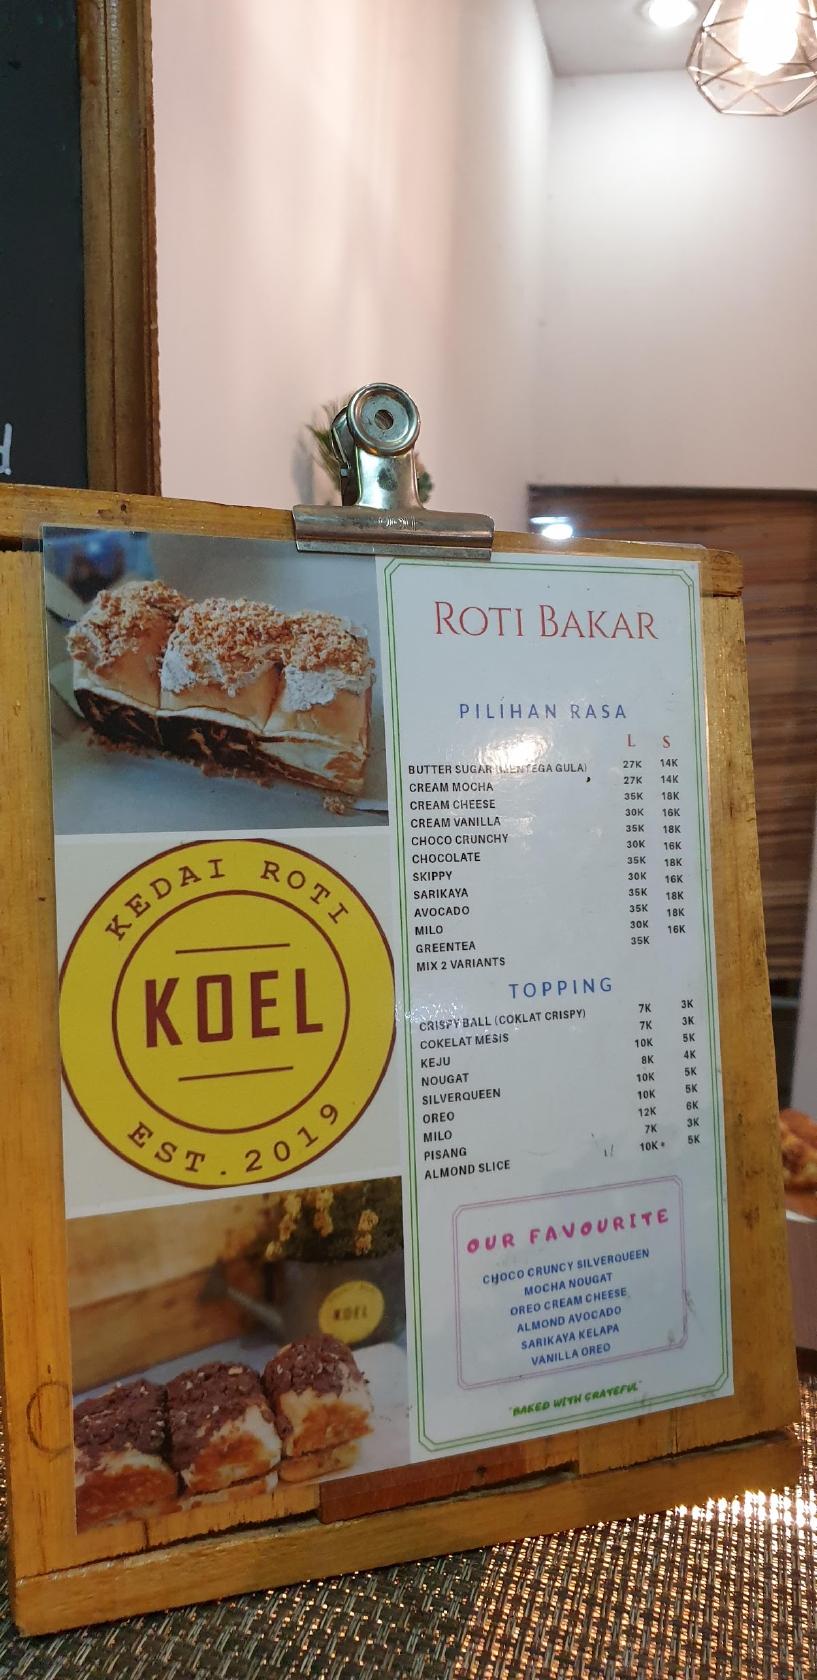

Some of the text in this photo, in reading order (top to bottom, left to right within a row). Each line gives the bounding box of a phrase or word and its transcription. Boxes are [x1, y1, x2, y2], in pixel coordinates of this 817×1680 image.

[460, 703, 626, 719] PILIHAN RASA
[627, 734, 670, 748] L S
[409, 765, 451, 774] BUTTER
[456, 765, 492, 774] SUGAR
[556, 763, 587, 772] GULA)
[623, 760, 642, 768] 27K
[660, 758, 678, 767] 14K
[409, 775, 679, 793] CREAM MOCHA 27K 14K
[410, 792, 679, 810] CREAM CHEESE 35K 18K
[410, 808, 680, 828] CREAM VANILLA 30K 16K
[411, 824, 681, 846] CHOCO CRUNCHY 35K 18K
[412, 840, 682, 864] CHOCOLATE 30K 16K
[413, 856, 682, 882] SKIPPY 35K 18K
[104, 858, 349, 941] KEDAI ROTI
[413, 872, 683, 900] SARIKAYA 30K 16K
[414, 888, 684, 918] AVOCADO 35K 18K
[415, 904, 685, 936] MILO 35K 18K
[416, 920, 686, 953] GREENTEA 30K 16K
[417, 936, 650, 972] MIX 2 VARIANTS 35K
[509, 977, 612, 999] TOPPING
[145, 968, 324, 1048] KOEL
[419, 999, 694, 1031] CRISPY BALL (COKLAT CRISPY) 7K 3K
[421, 1016, 694, 1049] COKELAT MESIS 7K 3K
[420, 1033, 695, 1068] KEJU 10K 5K
[421, 1050, 696, 1087] NOUGAT 8K 4K
[422, 1067, 697, 1105] SILVERQUEEN 10K 5K
[423, 1084, 698, 1124] OREO 10K 5K
[423, 1101, 699, 1142] MILO 12K 6K
[424, 1118, 699, 1161] PISANG 7K 3K
[424, 1135, 700, 1180] ALMOND SLICE 10K 5K
[467, 1208, 669, 1254] OUR FAVOURITE
[483, 1248, 650, 1284] CHOCO CRUNCY SILVERQUEEN
[524, 1273, 613, 1296] MOCHA NOUGAT
[510, 1287, 627, 1316] OREO CREAM CHEESE
[517, 1306, 622, 1333] ALMOND AVOCADO
[521, 1324, 619, 1350] SARIKAYA KELAPA
[531, 1343, 611, 1366] VANILLA OREO
[554, 1394, 581, 1408] WITH
